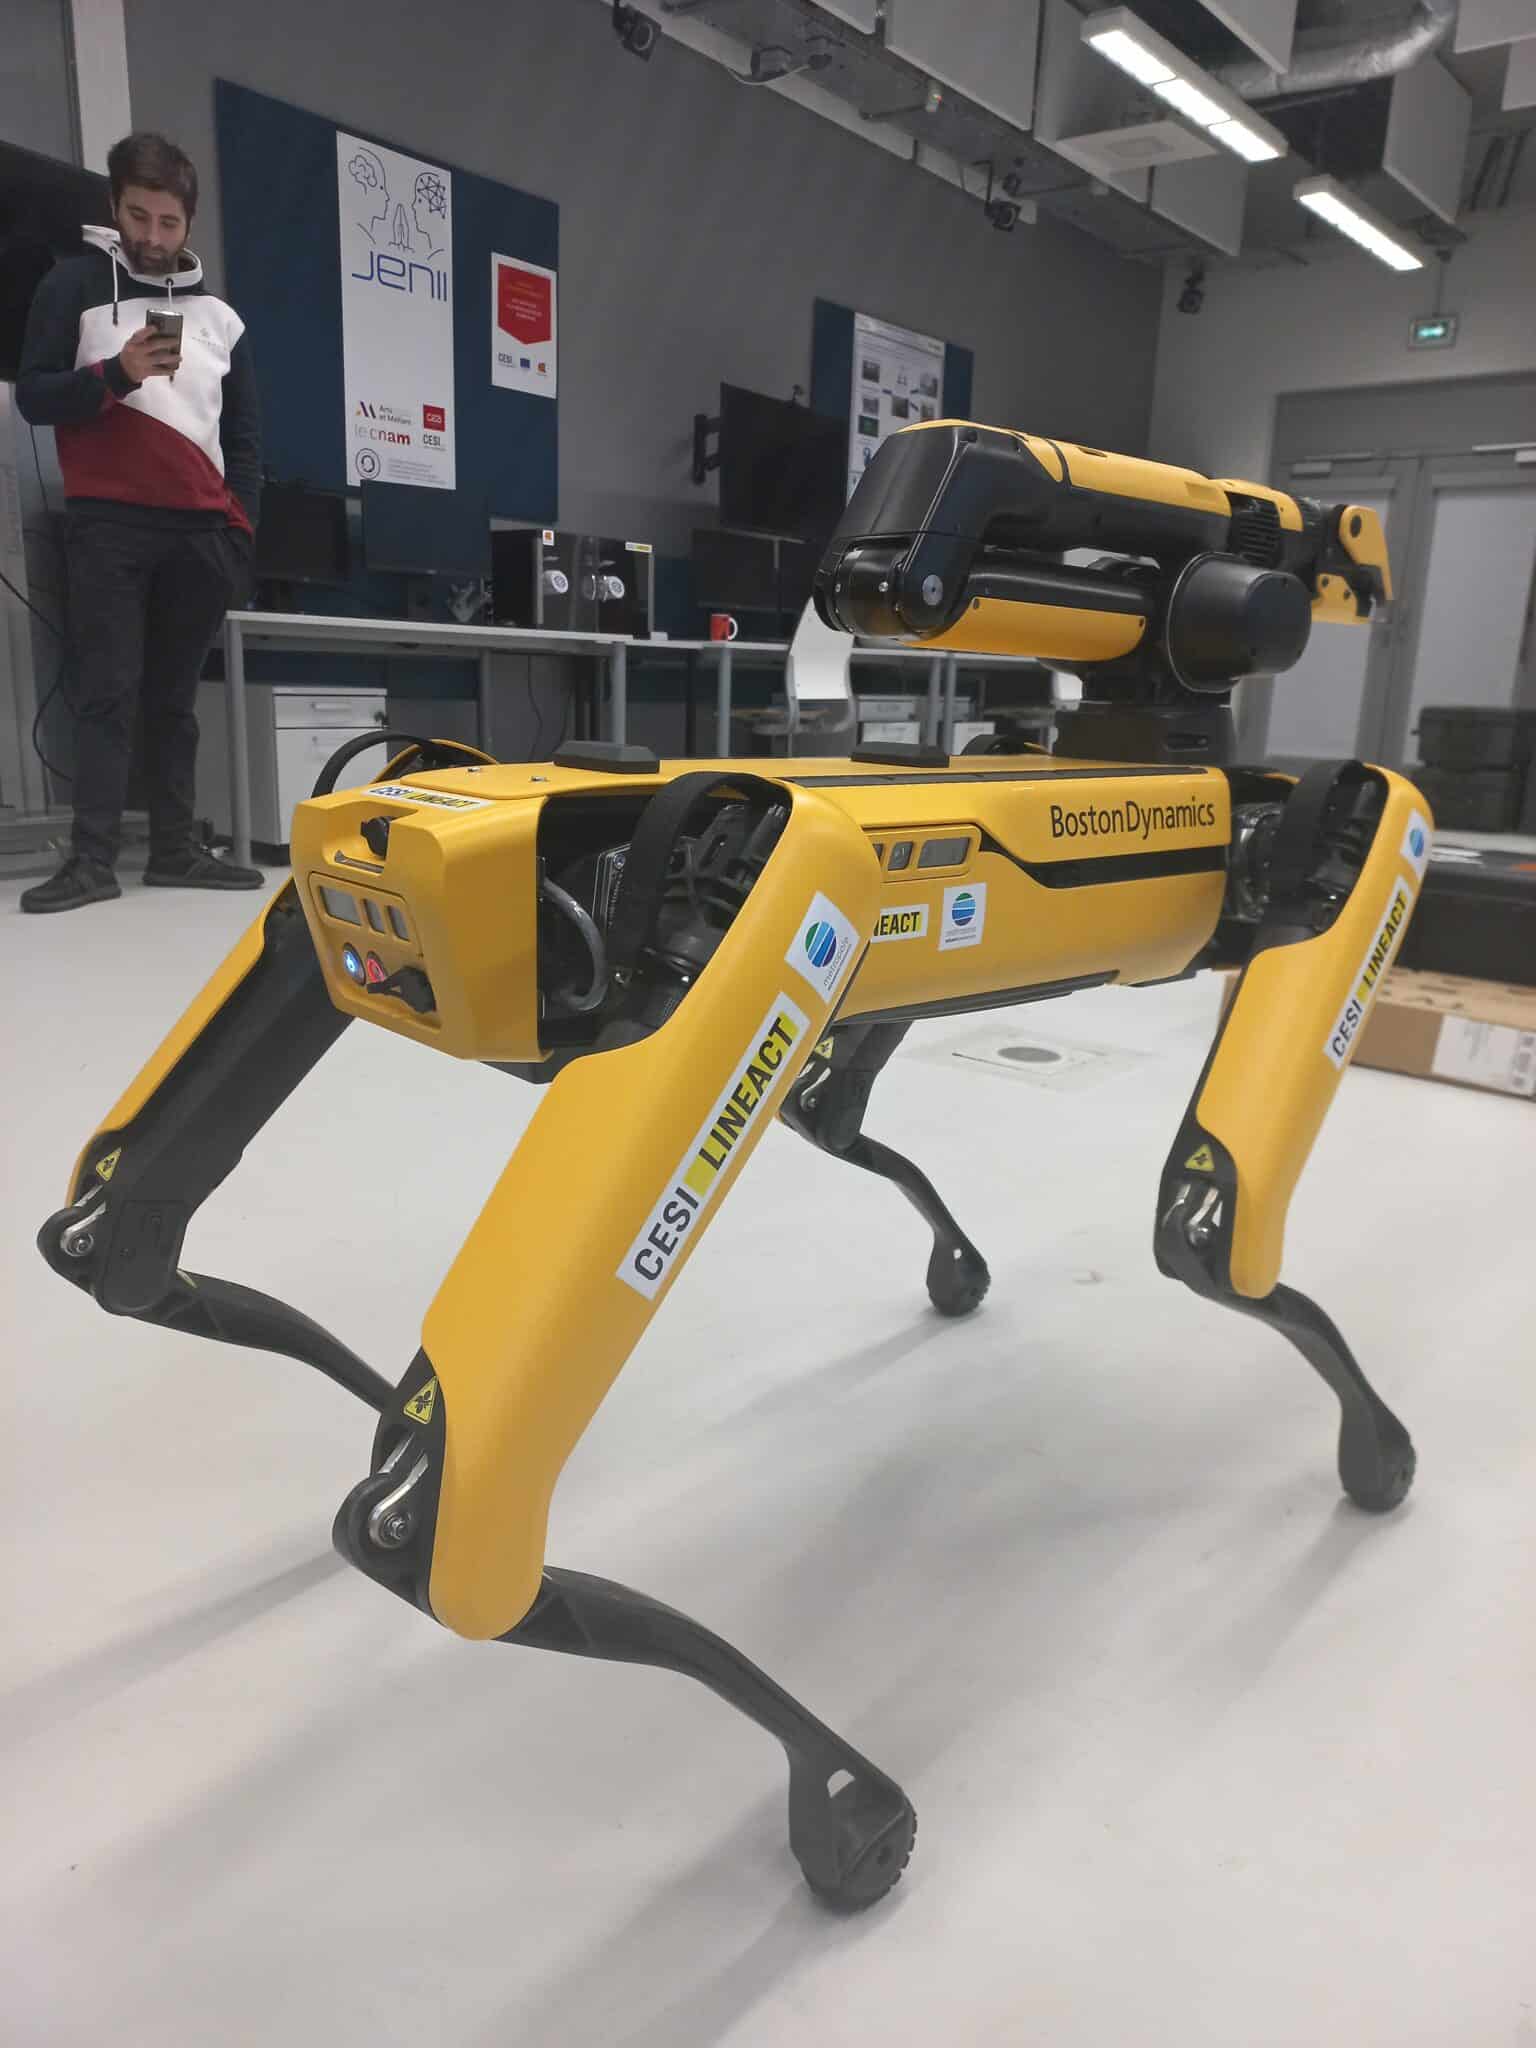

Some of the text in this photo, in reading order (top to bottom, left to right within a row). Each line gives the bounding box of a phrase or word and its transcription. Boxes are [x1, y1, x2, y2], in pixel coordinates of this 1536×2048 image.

[1332, 888, 1407, 1057] CESI LINEACT
[634, 1017, 793, 1281] CESI LINEACT
